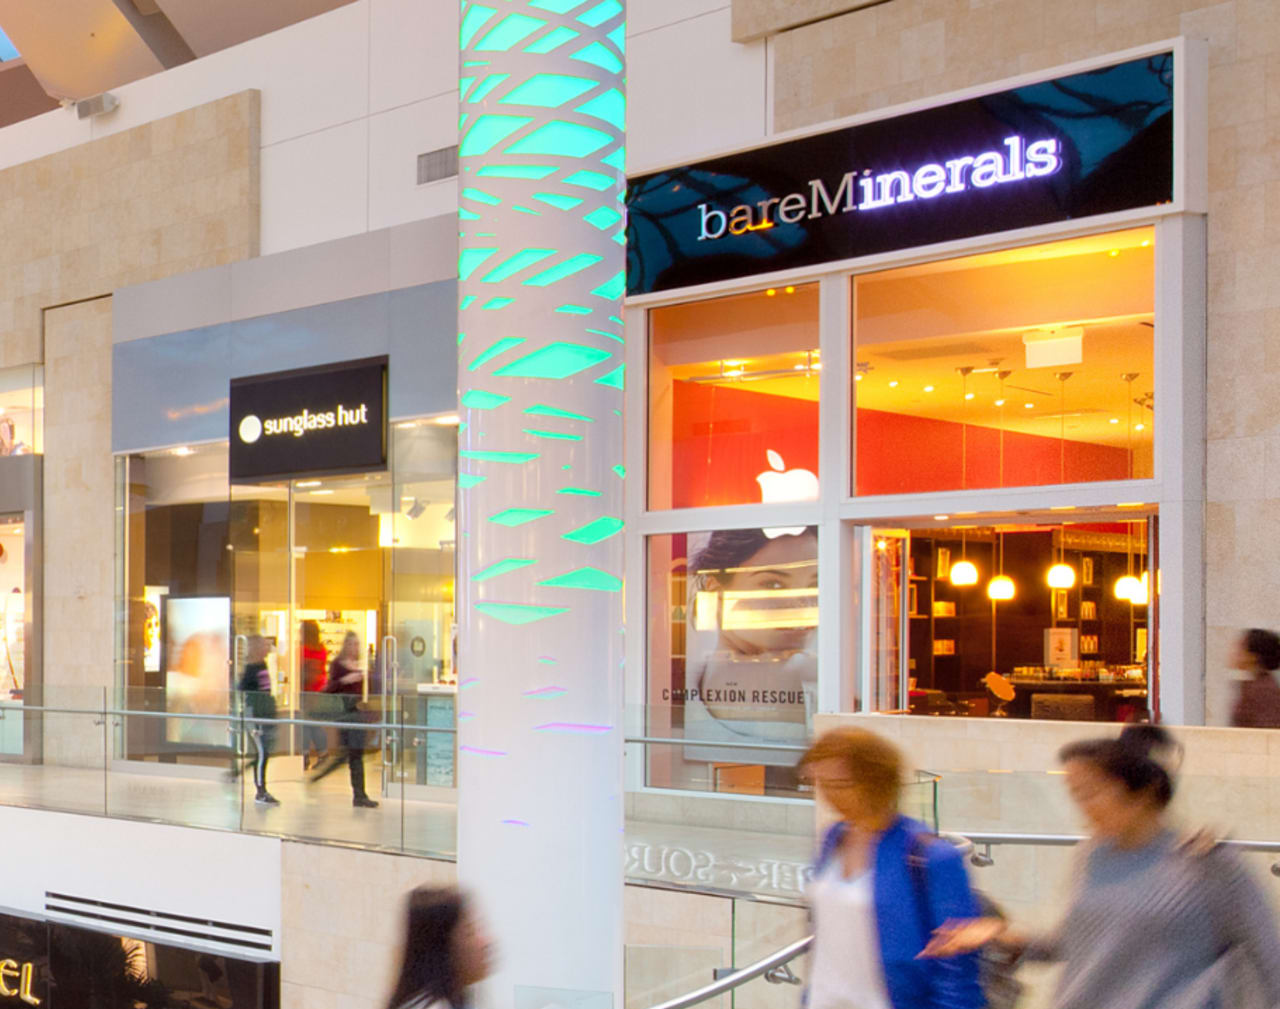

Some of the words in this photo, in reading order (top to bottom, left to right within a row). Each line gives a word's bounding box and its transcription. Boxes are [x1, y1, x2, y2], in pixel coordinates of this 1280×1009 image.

[697, 135, 1061, 240] bareMinerals
[264, 409, 335, 437] sunglass
[337, 404, 368, 426] hut
[752, 690, 804, 704] RESCUE
